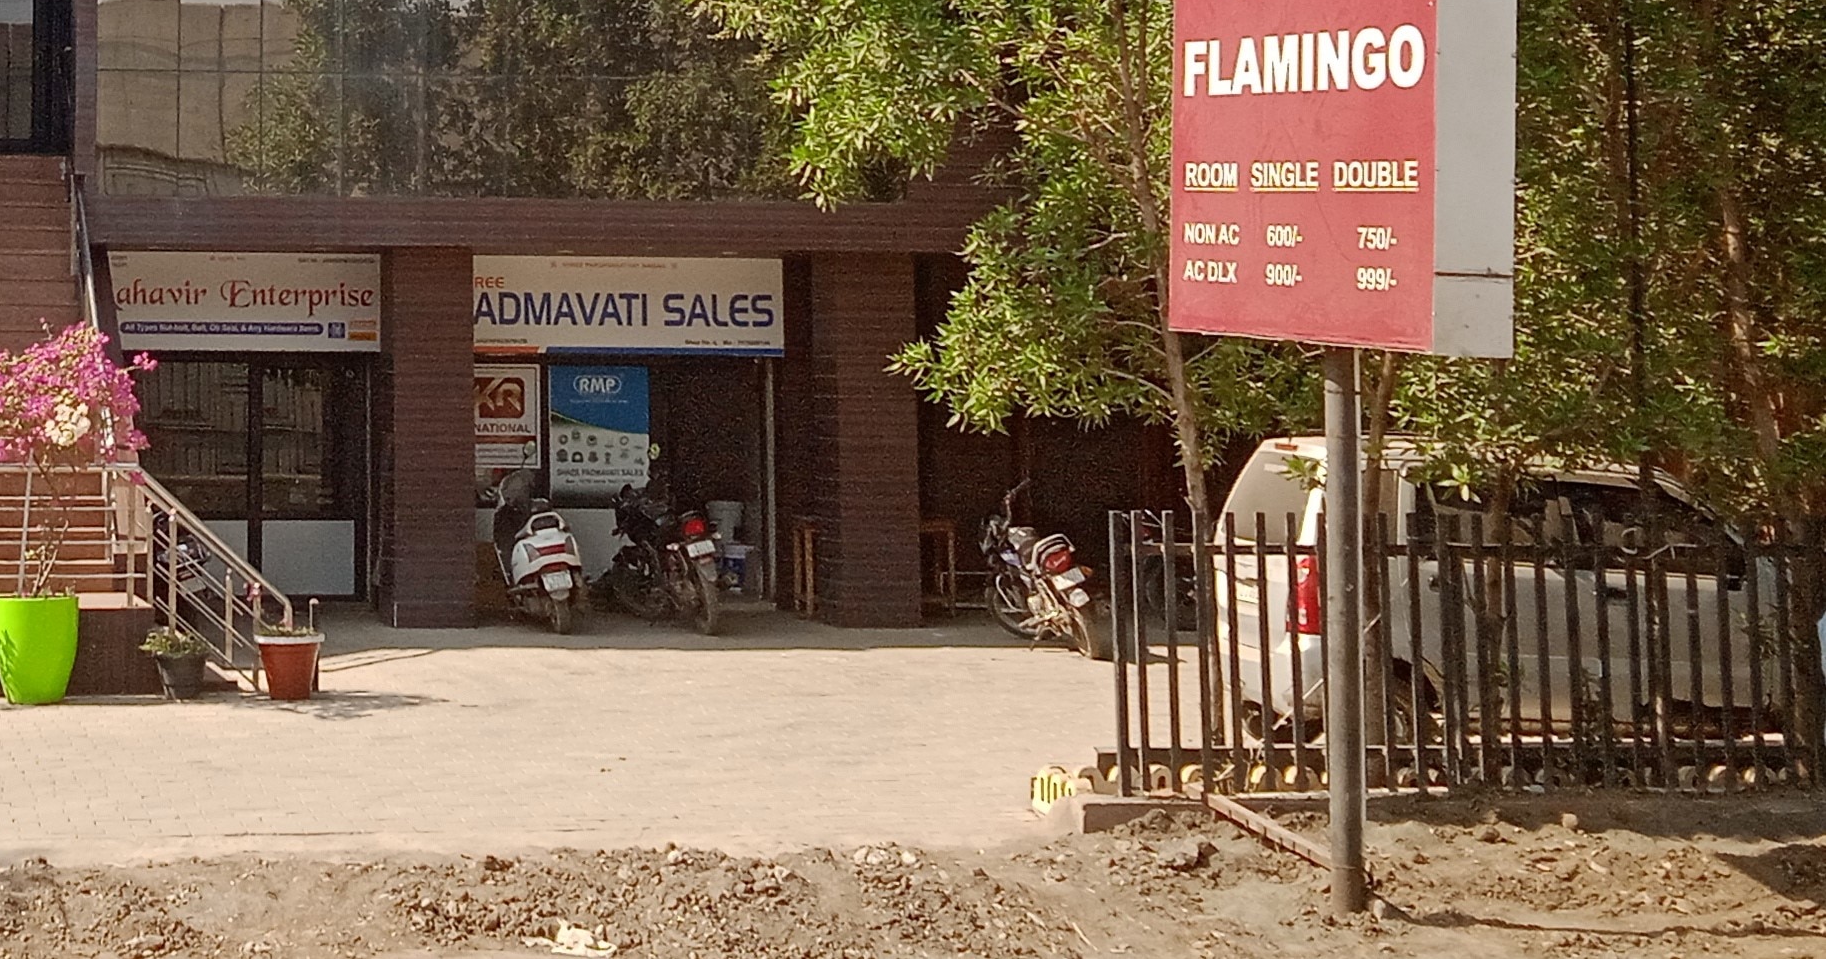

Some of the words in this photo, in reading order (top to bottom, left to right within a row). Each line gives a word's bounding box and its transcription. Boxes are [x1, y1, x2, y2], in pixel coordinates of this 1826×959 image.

[1183, 24, 1425, 97] FLAMINGO
[1185, 162, 1239, 188] ROOM
[1250, 162, 1320, 188] SINGLE
[1333, 161, 1419, 188] DOUBLE
[1184, 223, 1216, 244] NON
[1218, 224, 1240, 245] AC
[1266, 224, 1303, 248] 600/-
[1357, 227, 1397, 250] 750/-
[1183, 261, 1205, 282] AC
[1207, 262, 1238, 284] DLX
[1265, 264, 1303, 287] 900/-
[1357, 268, 1397, 292] 999/-
[115, 279, 207, 310] ahavir
[220, 279, 375, 318] Enterprise
[474, 291, 648, 327] ADMAVATI
[663, 293, 775, 328] SALES
[578, 377, 616, 393] RMP
